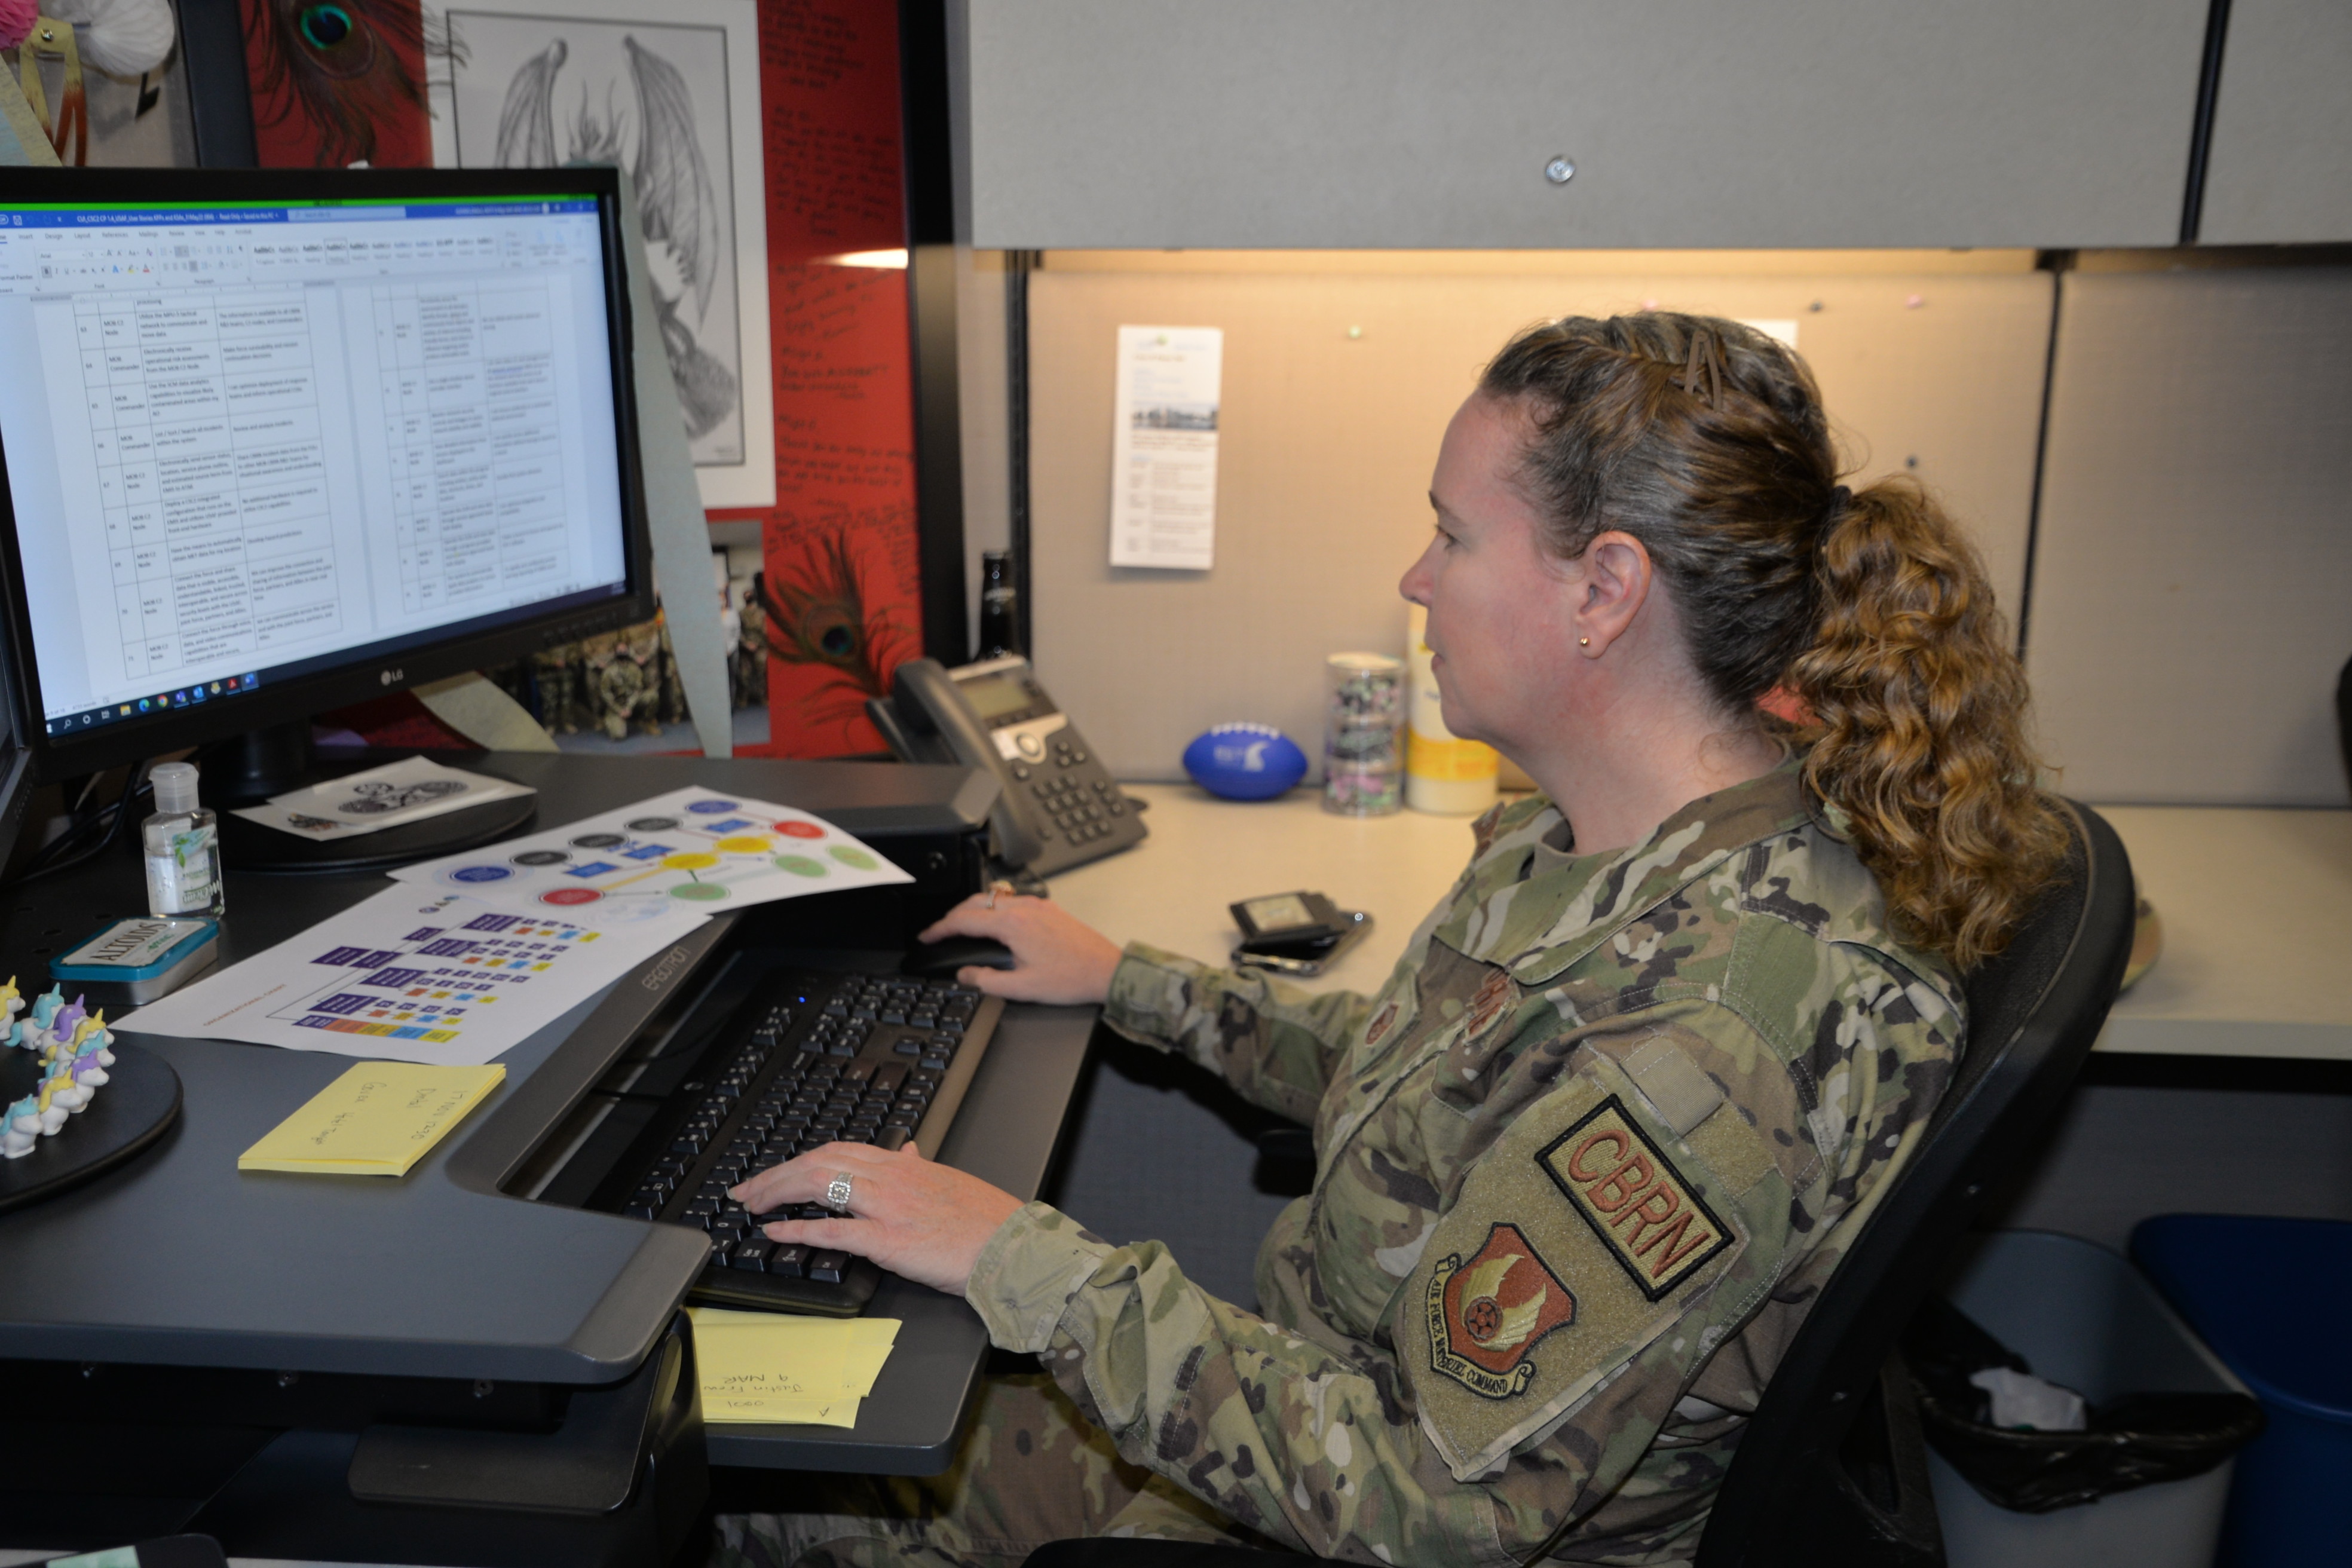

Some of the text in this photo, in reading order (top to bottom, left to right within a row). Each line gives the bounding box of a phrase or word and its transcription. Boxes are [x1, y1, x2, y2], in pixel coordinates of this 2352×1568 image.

[391, 668, 403, 682] LG
[90, 923, 167, 961] ALTOIDS
[641, 945, 691, 991] ERGOTRON
[1568, 1128, 1710, 1279] CBRN
[1430, 1279, 1441, 1299] AIR
[1430, 1303, 1444, 1338] FORCE
[724, 1374, 765, 1384] MAR
[754, 1383, 803, 1393] Justin
[1466, 1368, 1508, 1394] COMMAND
